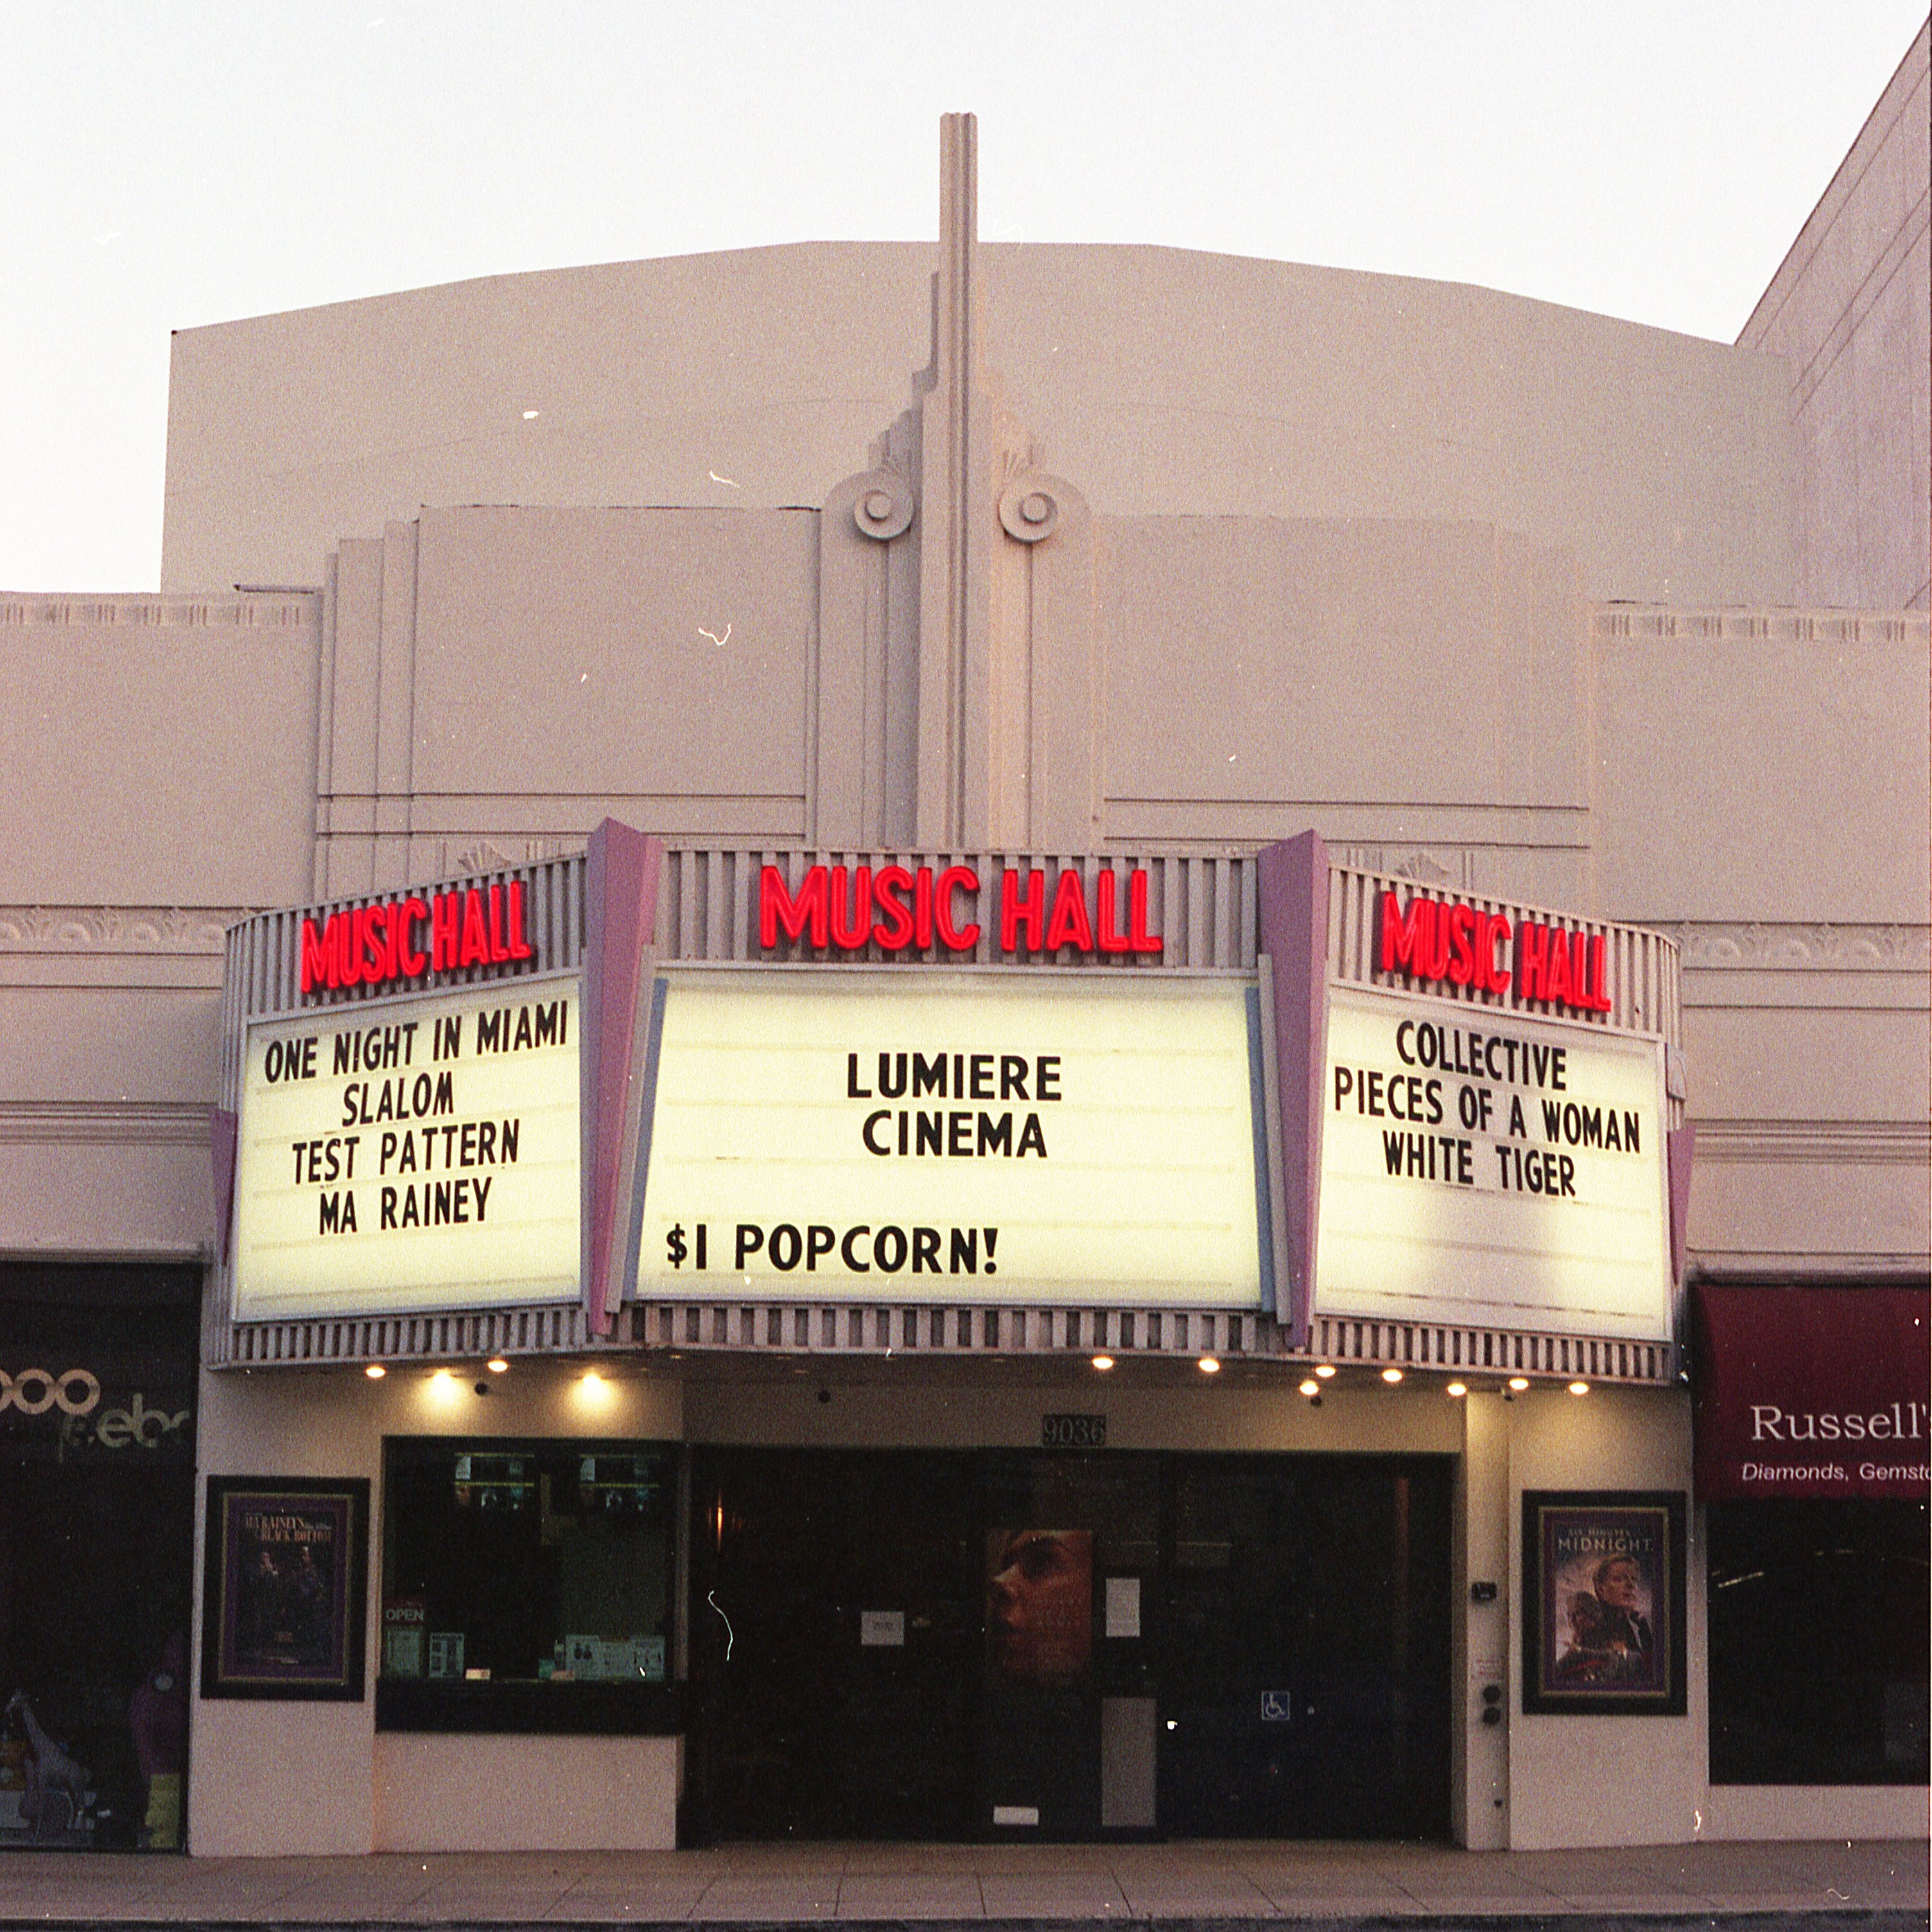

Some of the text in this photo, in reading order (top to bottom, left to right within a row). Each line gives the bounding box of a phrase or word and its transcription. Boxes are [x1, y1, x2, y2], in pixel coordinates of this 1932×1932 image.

[301, 880, 532, 993] MUSIC HALL
[760, 865, 1163, 952] MUSIC HALL
[1382, 891, 1612, 1012] MUSIC HALL
[265, 1000, 568, 1083] ONE NIGHT IN MIAMI
[1397, 1020, 1566, 1090] COLLECTIVE
[342, 1071, 453, 1127] SLALOM
[847, 1053, 1062, 1101] LUMIERE
[862, 1110, 1048, 1158] CINEMA
[1335, 1066, 1640, 1154] PIECES OF A WOMAN
[293, 1118, 519, 1184] TEST PATTERN
[1382, 1130, 1576, 1197] WHITE TIGER
[320, 1176, 492, 1235] MA RAINEY
[735, 1223, 998, 1275] POPCORN!
[0, 1368, 101, 1415] oo
[1044, 1418, 1105, 1445] 9036
[1743, 1463, 1849, 1482] Diamonds,
[1558, 1538, 1651, 1551] MIDNIGHT
[386, 1608, 424, 1621] OPEN
